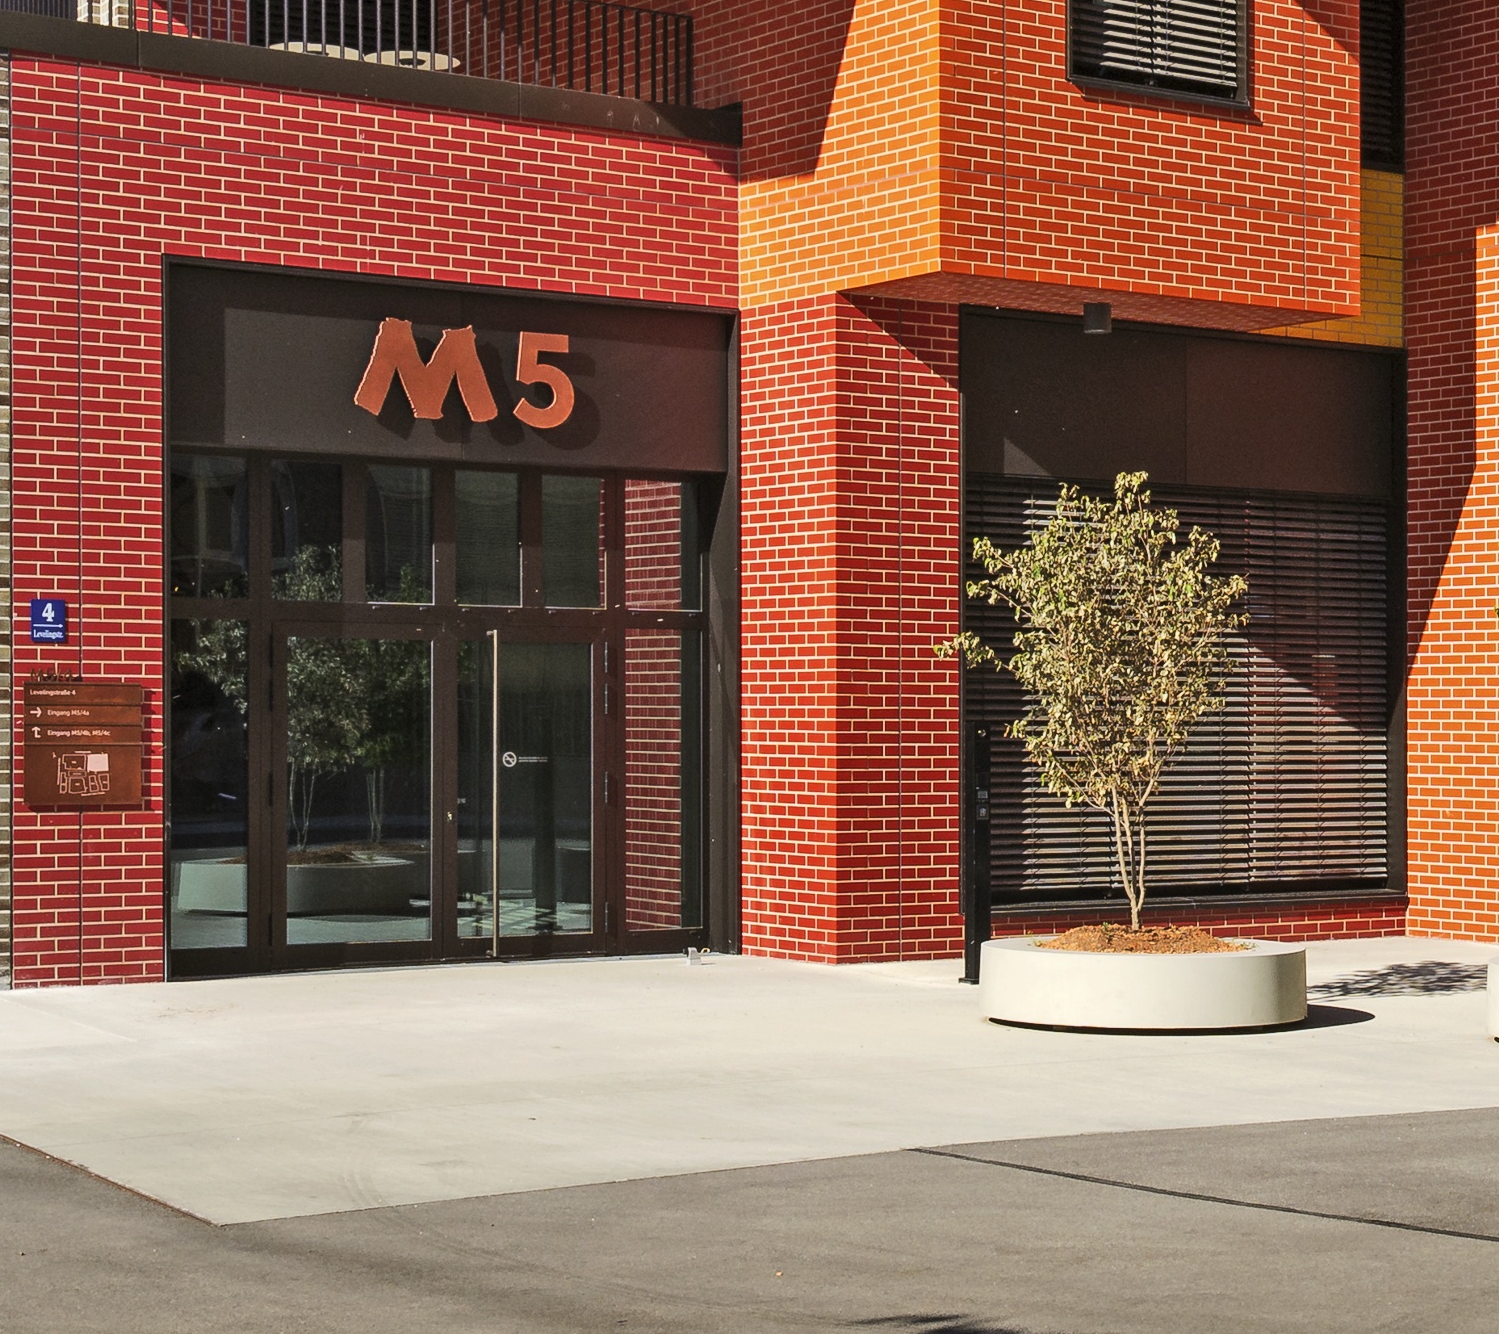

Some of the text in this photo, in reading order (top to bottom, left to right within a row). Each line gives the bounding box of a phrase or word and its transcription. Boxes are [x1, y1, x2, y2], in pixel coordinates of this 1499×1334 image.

[354, 317, 575, 429] M5
[41, 602, 55, 622] 4
[29, 689, 71, 697] Levelingstraße
[47, 709, 71, 717] Eingang
[47, 729, 71, 737] Eingang
